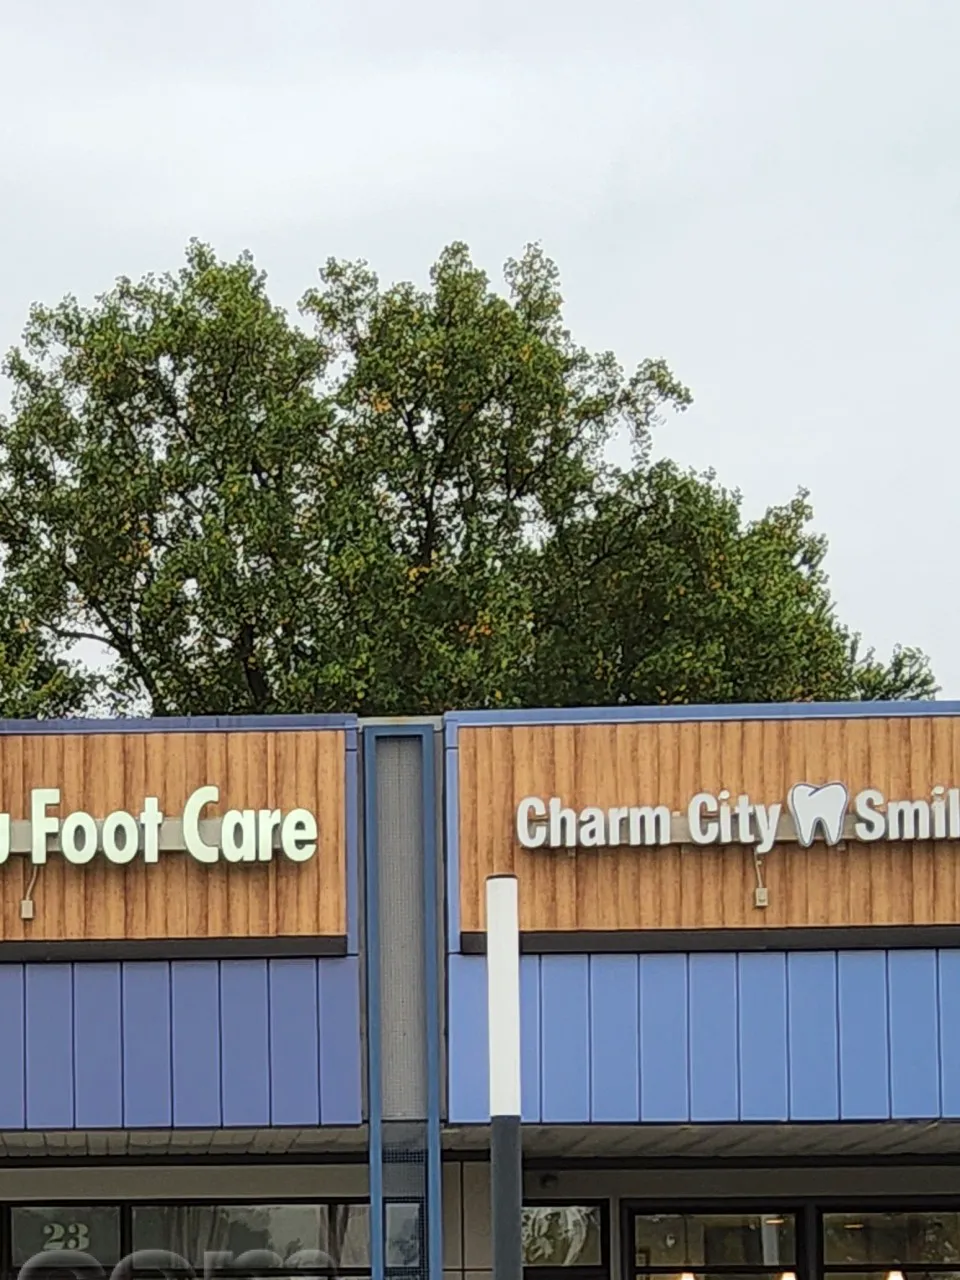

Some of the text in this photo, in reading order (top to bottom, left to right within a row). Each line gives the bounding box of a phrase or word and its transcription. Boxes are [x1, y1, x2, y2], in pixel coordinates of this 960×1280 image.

[31, 788, 162, 865] Foot
[182, 785, 318, 864] Care
[516, 786, 960, 853] Charm City Smil
[43, 1223, 89, 1250] 23
